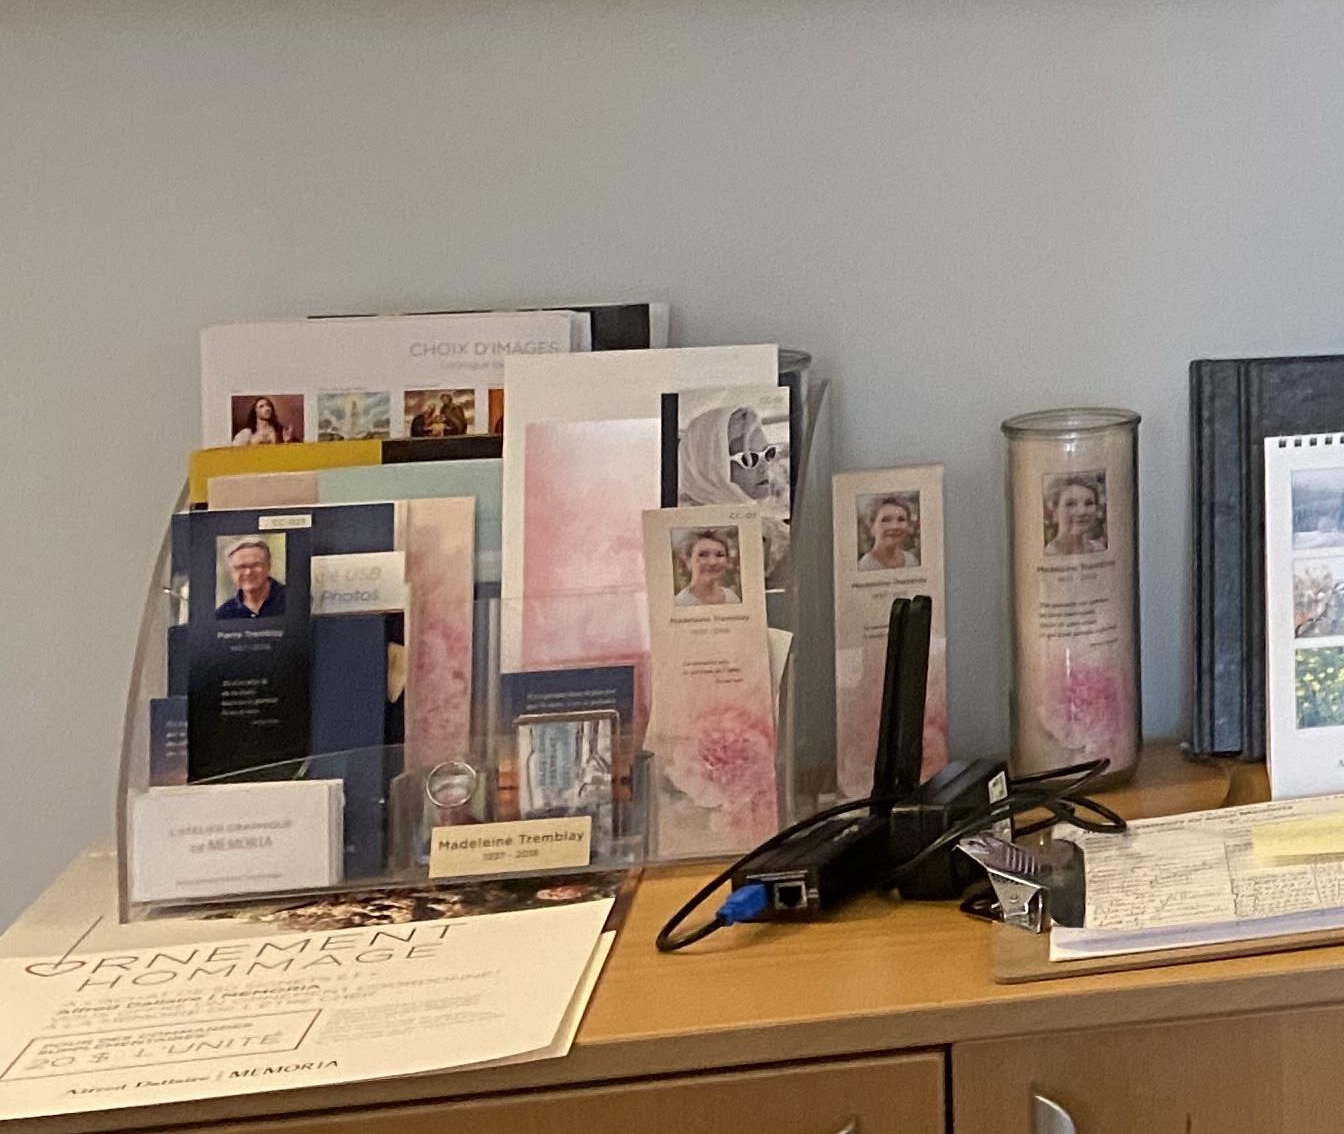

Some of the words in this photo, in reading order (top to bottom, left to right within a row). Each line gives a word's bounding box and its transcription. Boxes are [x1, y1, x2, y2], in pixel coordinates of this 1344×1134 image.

[409, 342, 469, 357] CHOIX
[438, 837, 514, 851] Madeleine
[517, 830, 585, 845] Tremblay
[77, 942, 445, 993] HOMMAGE
[25, 1056, 76, 1070] 20
[229, 1060, 339, 1079] MEMORIA
